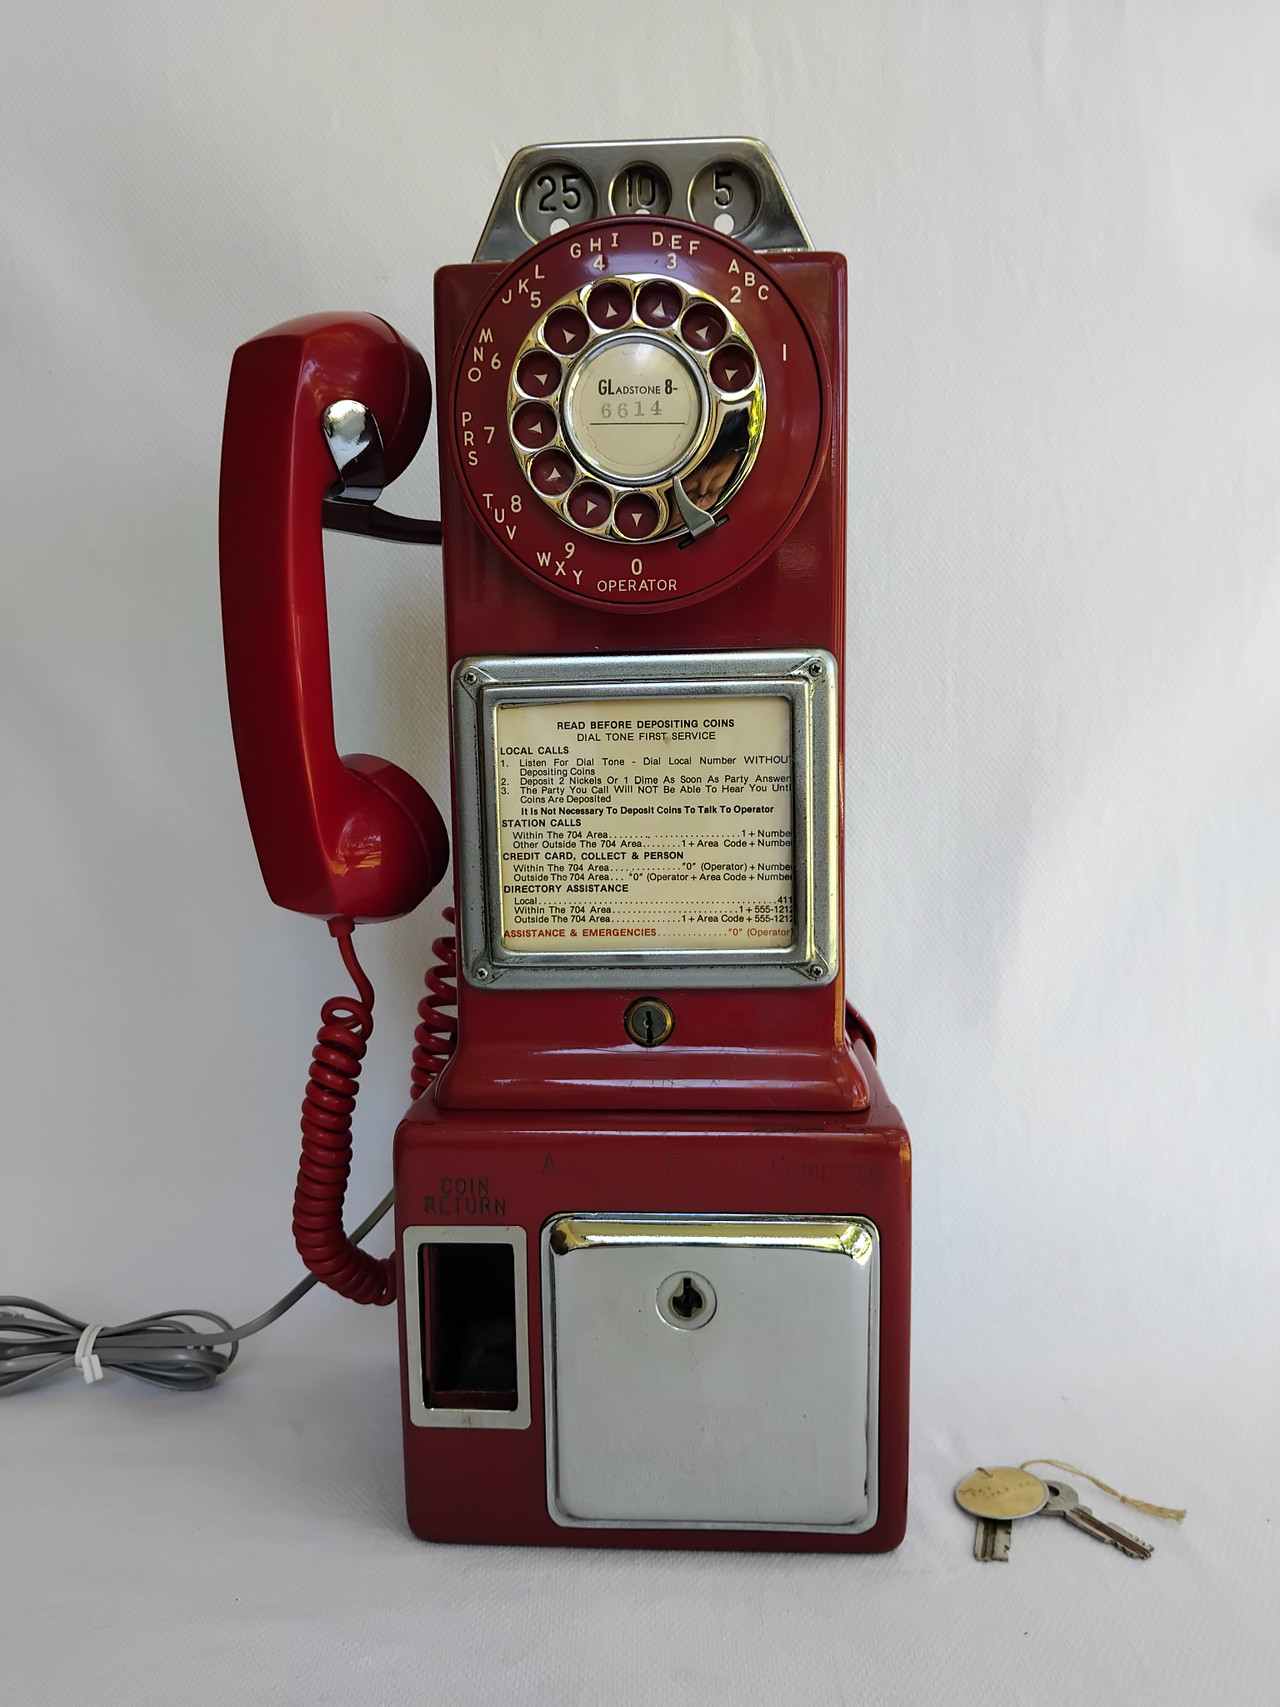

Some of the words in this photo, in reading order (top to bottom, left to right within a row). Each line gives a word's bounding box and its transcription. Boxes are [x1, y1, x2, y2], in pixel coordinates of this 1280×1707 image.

[537, 174, 581, 212] 25
[625, 173, 656, 208] 10
[712, 171, 733, 206] 5
[593, 253, 605, 271] 4
[666, 253, 678, 270] 3
[530, 290, 542, 308] 5
[730, 286, 742, 303] 2
[491, 352, 502, 370] 6
[664, 379, 678, 396] 8-
[601, 401, 664, 421] 6614
[484, 426, 495, 444] 7
[510, 495, 522, 513] 8
[564, 542, 575, 559] 9
[597, 577, 678, 594] OPERATOR
[557, 721, 585, 730] READ
[591, 720, 632, 729] BEFORE
[637, 720, 699, 729] DEPOSITING
[703, 719, 734, 728] COINS
[577, 733, 601, 741] DIAL
[606, 733, 635, 741] TONE
[639, 732, 666, 741] FIRST
[672, 732, 716, 740] SERVICE
[500, 747, 534, 755] LOCAL
[538, 746, 569, 755] CALLS
[501, 759, 509, 767] 1.
[519, 758, 548, 767] Listen
[554, 758, 569, 767] For
[576, 758, 594, 766] Dial
[602, 758, 625, 766] Tone
[643, 757, 661, 766] Dial
[668, 757, 692, 765] Local
[700, 756, 736, 765] Number
[520, 768, 568, 777] Depositing
[501, 777, 510, 785] 2.
[520, 777, 554, 787] Deposit
[559, 777, 565, 785] 2
[569, 776, 602, 784] Nickels
[607, 776, 618, 784] Or
[624, 776, 628, 784] 1
[634, 776, 658, 784] Dime
[663, 776, 675, 784] As
[680, 776, 702, 784] Soon
[707, 775, 719, 783] As
[725, 775, 748, 785] Party
[501, 786, 510, 794] 3.
[520, 786, 537, 794] The
[541, 786, 565, 796] Party
[569, 786, 587, 794] You
[592, 786, 609, 794] Call
[638, 785, 658, 793] NOT
[664, 785, 675, 793] Be
[680, 785, 701, 793] Able
[706, 785, 717, 793] To
[722, 785, 744, 793] Hear
[520, 796, 545, 804] Coins
[548, 795, 564, 803] Are
[567, 795, 611, 805] Deposited
[521, 807, 528, 815] It
[530, 807, 538, 815] Is
[540, 807, 556, 815] Not
[558, 807, 603, 817] Necessary
[606, 807, 618, 815] To
[620, 806, 655, 816] Deposit
[657, 806, 682, 814] Coins
[684, 806, 696, 814] To
[697, 806, 717, 814] Talk
[719, 806, 731, 814] To
[733, 806, 774, 816] Operator
[502, 819, 546, 827] STATION
[550, 819, 581, 827] CALLS
[513, 831, 544, 839] Within
[547, 831, 564, 839] The
[567, 831, 584, 839] 704
[513, 841, 540, 849] Other
[543, 840, 576, 848] Outside
[580, 840, 597, 848] The
[600, 840, 616, 848] 704
[697, 839, 719, 847] Area
[724, 839, 747, 847] Code
[503, 852, 540, 860] CREDIT
[544, 852, 576, 861] CARD,
[581, 852, 627, 860] COLLECT
[632, 852, 639, 860] &
[514, 864, 544, 872] Within
[548, 864, 565, 872] The
[568, 864, 585, 872] 704
[701, 863, 747, 873] (Operator)
[514, 873, 549, 881] Outside
[570, 873, 585, 881] 704
[646, 873, 689, 883] (Operator
[699, 873, 721, 881] Area
[723, 873, 747, 881] Code
[504, 885, 562, 893] DIRECTORY
[566, 884, 629, 893] ASSISTANCE
[514, 906, 545, 914] Within
[548, 906, 565, 914] The
[570, 906, 585, 914] 704
[514, 915, 549, 923] Outside
[552, 915, 568, 923] The
[570, 915, 586, 923] 704
[697, 915, 719, 923] Area
[721, 915, 745, 923] Code
[504, 929, 565, 937] ASSISTANCE
[570, 929, 578, 937] &
[439, 1176, 490, 1197] COIN
[424, 1195, 507, 1216] RETURN
